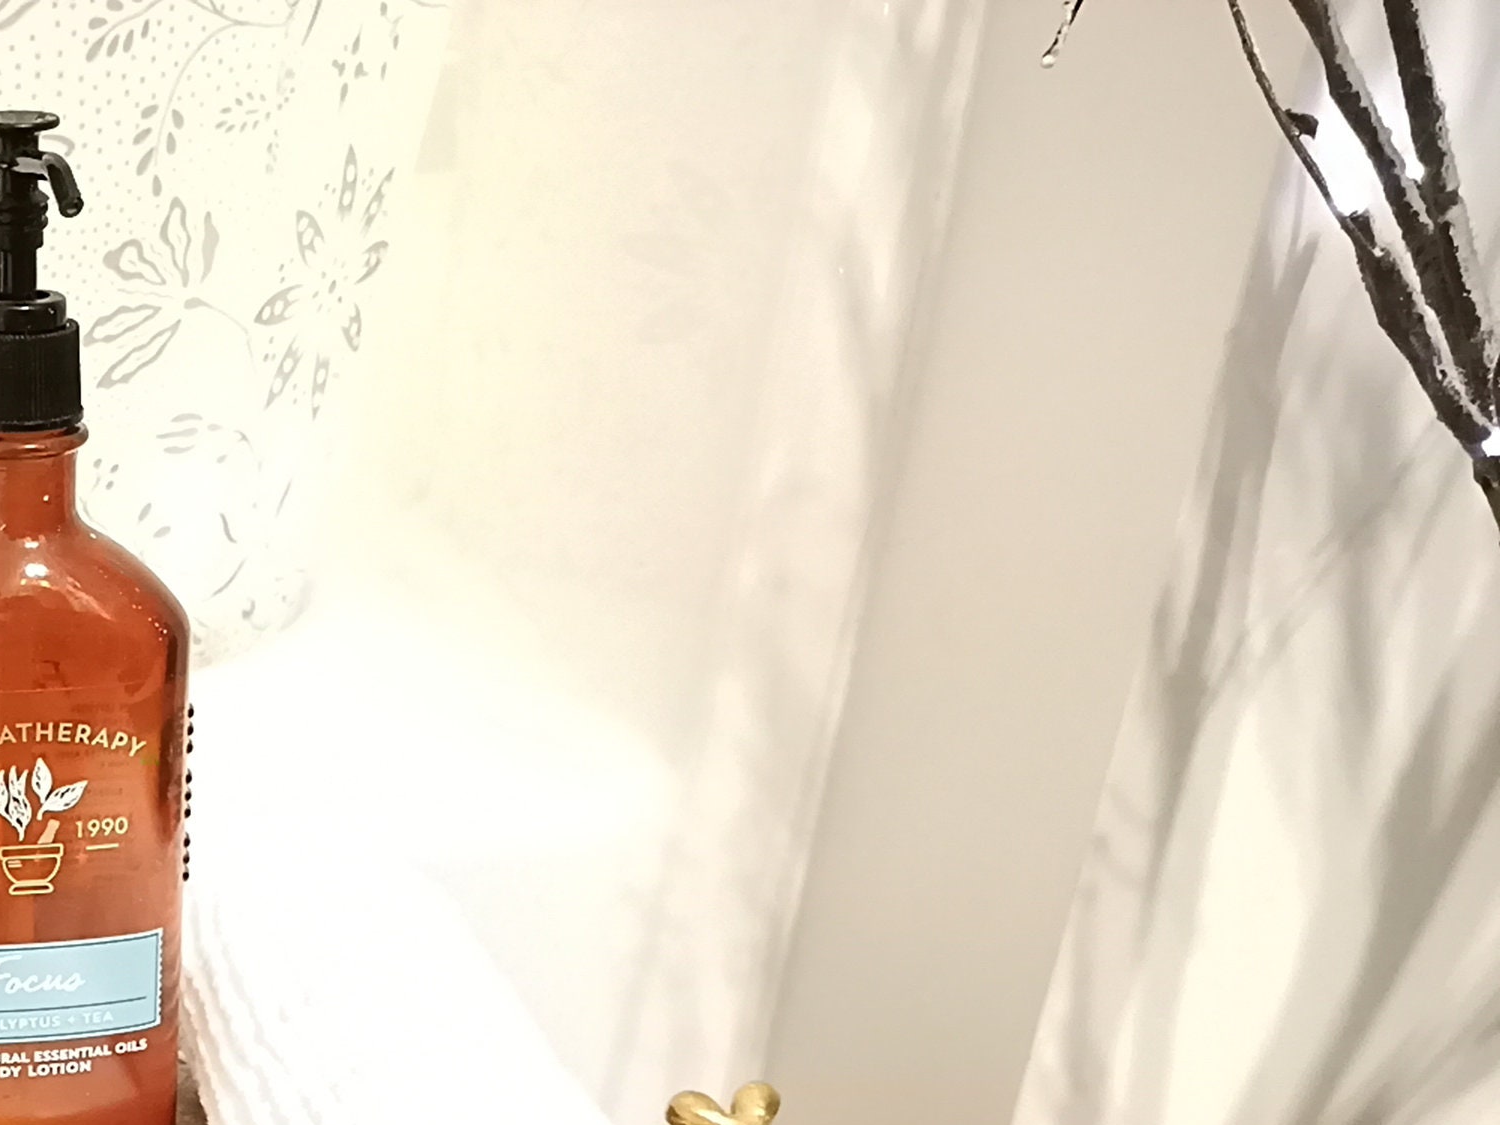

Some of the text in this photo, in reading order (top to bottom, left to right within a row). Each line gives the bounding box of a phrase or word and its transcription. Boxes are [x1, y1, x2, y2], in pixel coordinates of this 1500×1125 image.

[75, 817, 129, 839] 1990
[82, 1012, 114, 1025] TEA
[34, 1047, 112, 1063] ESSENTIAL
[115, 1038, 148, 1055] OILS
[27, 1061, 92, 1078] LOTION
